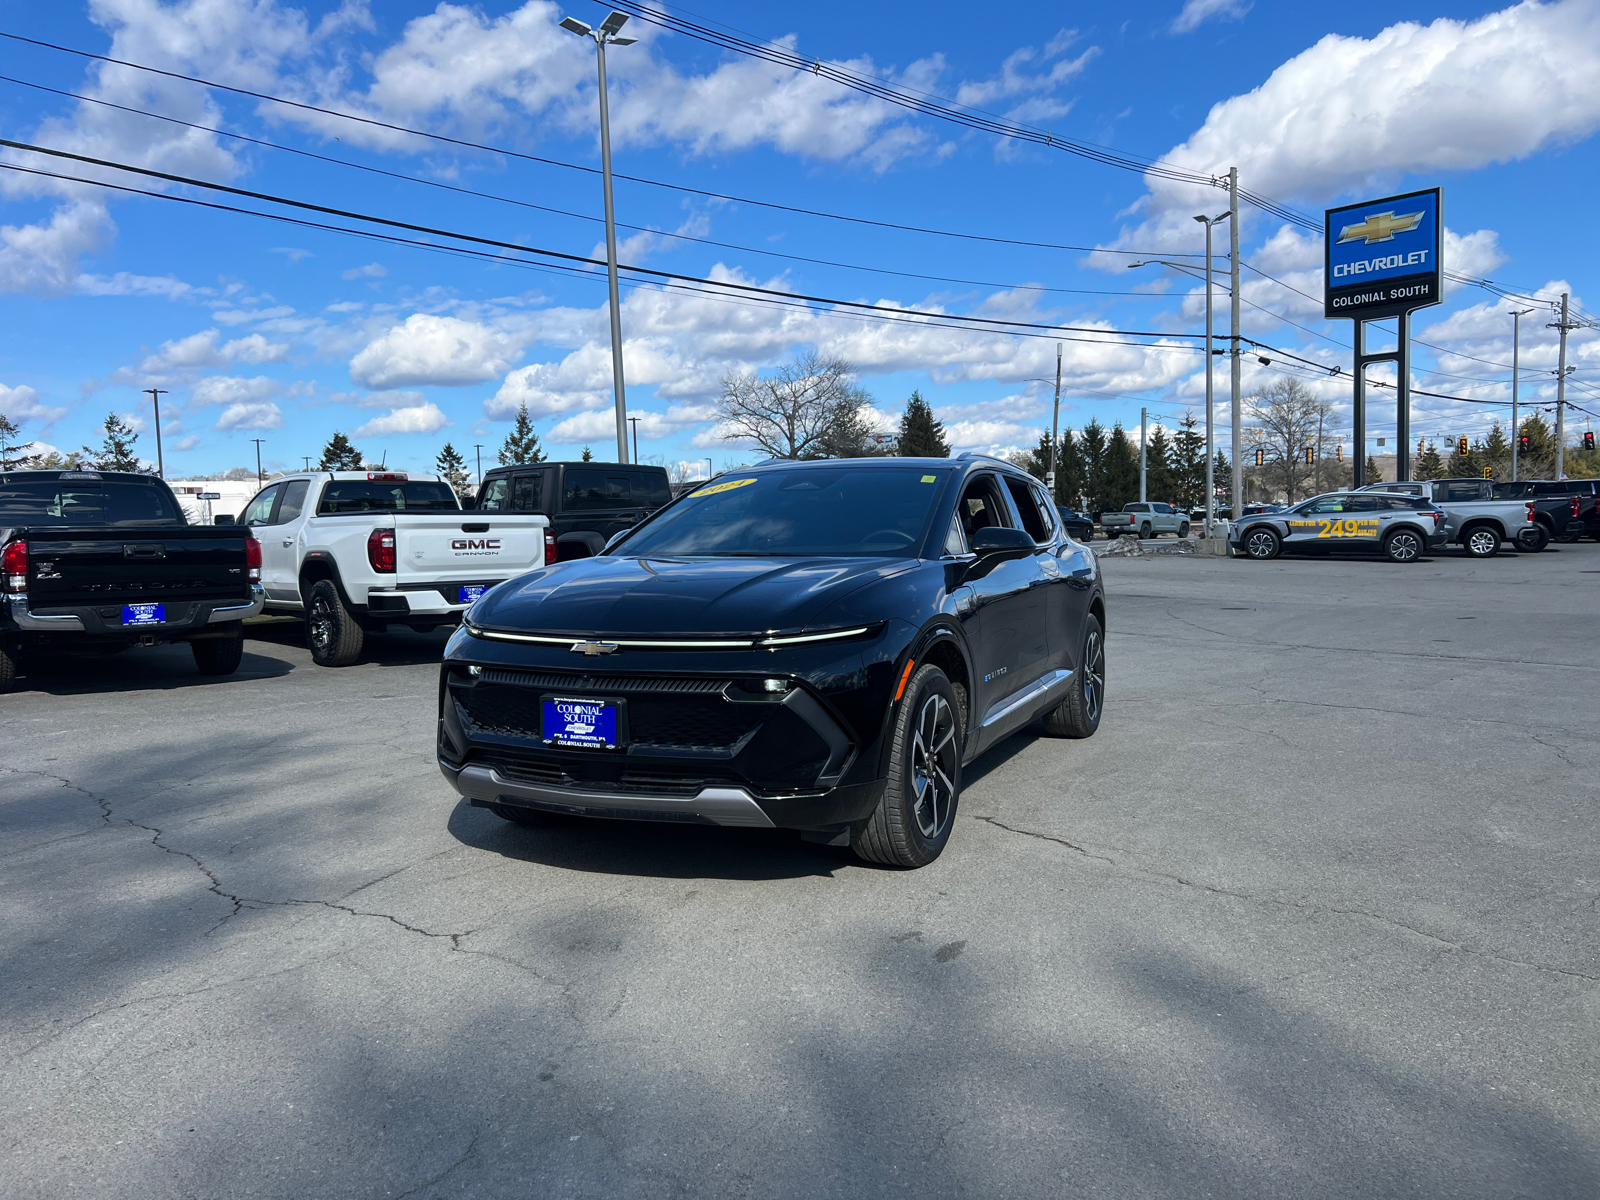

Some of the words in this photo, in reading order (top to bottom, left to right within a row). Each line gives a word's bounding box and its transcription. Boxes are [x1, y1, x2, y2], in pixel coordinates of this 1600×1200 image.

[1334, 250, 1428, 278] CHEVROLET
[1332, 292, 1386, 308] COLONIAL
[1390, 284, 1428, 298] SOUTH
[452, 540, 500, 550] GMC
[82, 580, 206, 592] TACOMA
[557, 704, 602, 715] COLONIAL
[564, 714, 596, 723] SOUTH
